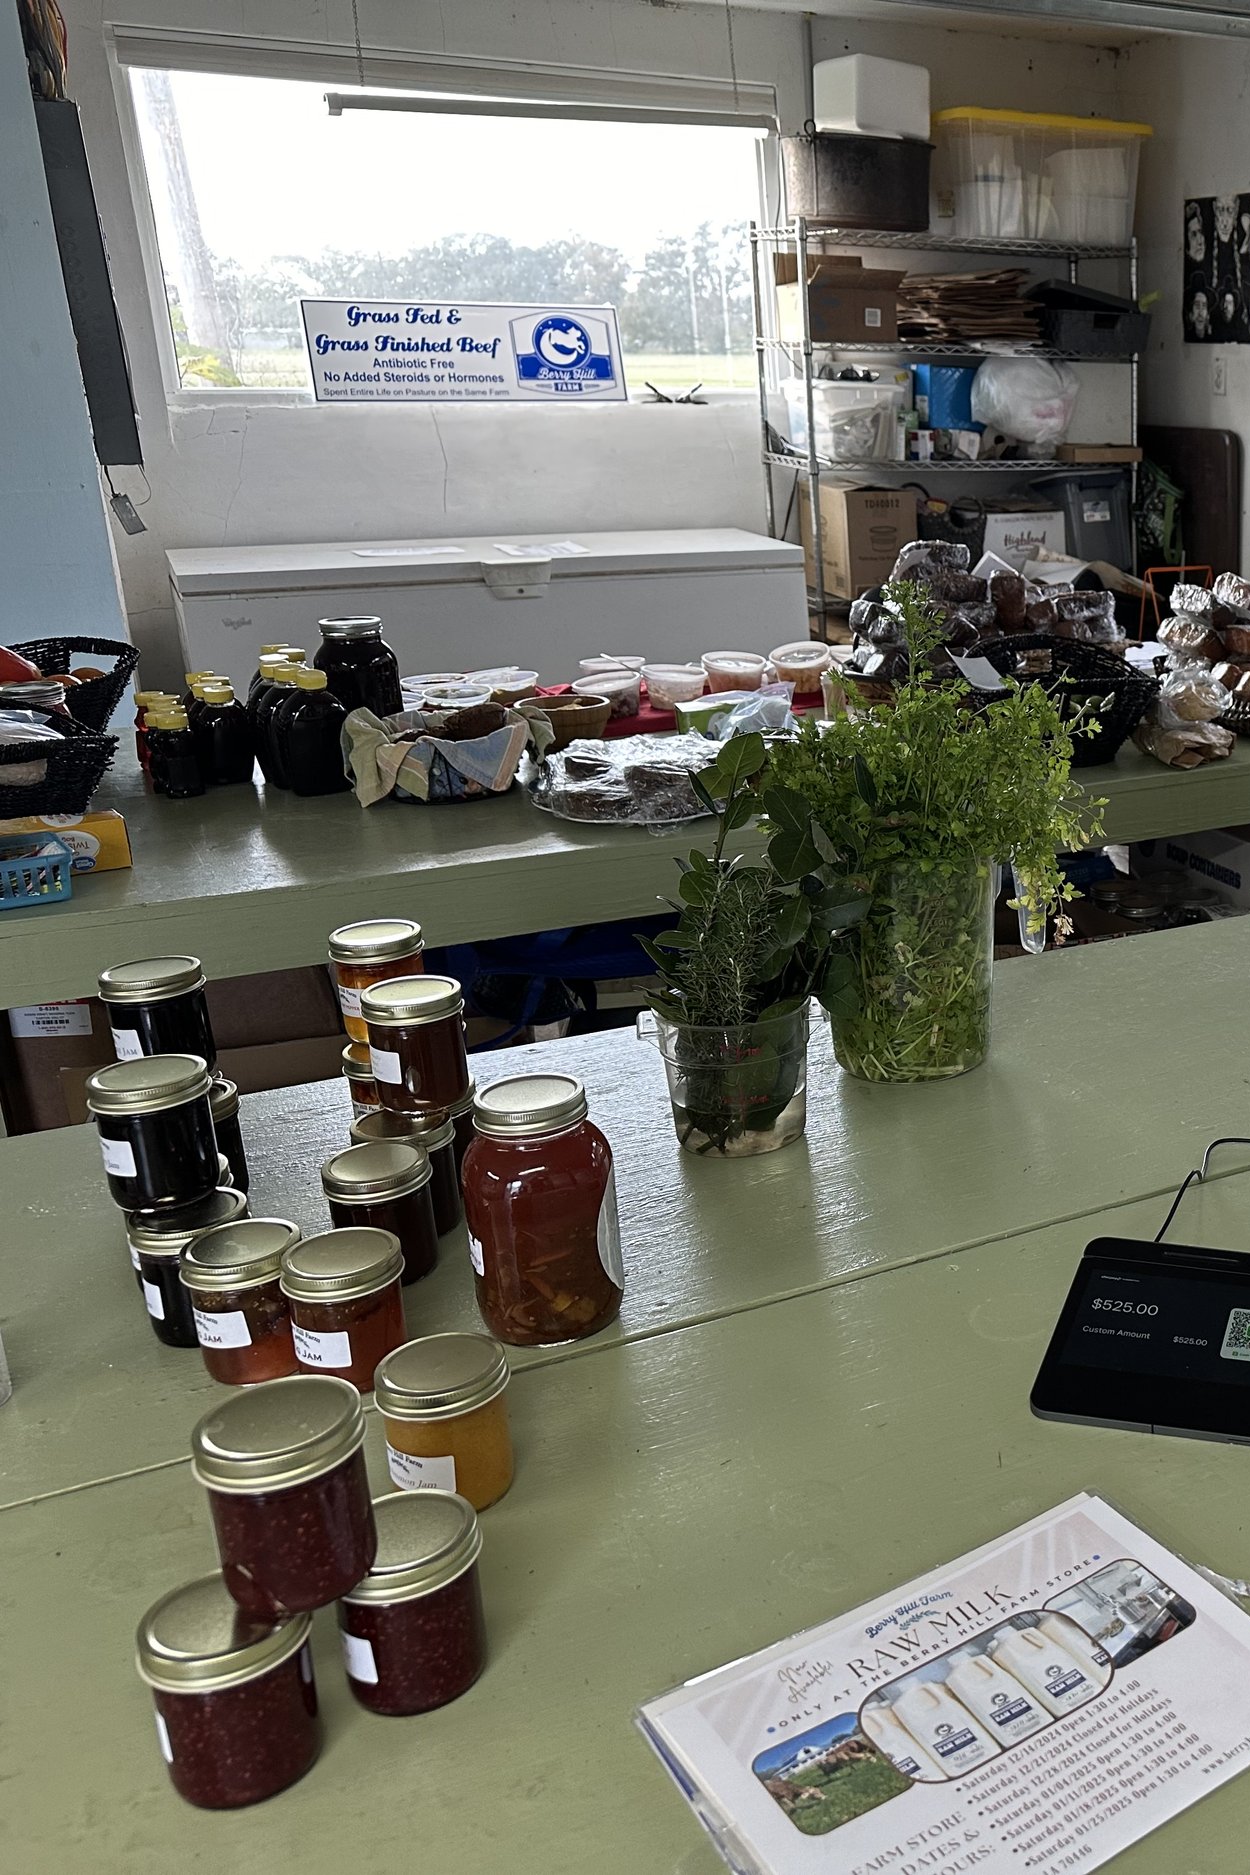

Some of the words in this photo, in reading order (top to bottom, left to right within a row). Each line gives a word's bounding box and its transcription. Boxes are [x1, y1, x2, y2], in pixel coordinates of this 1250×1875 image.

[347, 305, 400, 327] Grass
[405, 306, 442, 324] Fed
[447, 308, 462, 324] &
[315, 333, 369, 356] Grass
[374, 335, 451, 353] Finished
[456, 337, 501, 358] Beef
[373, 357, 428, 369] Antibiotic
[430, 358, 454, 369] Free
[538, 368, 571, 382] Berry
[573, 368, 596, 380] Hill
[324, 371, 340, 383] No
[344, 371, 381, 383] Added
[384, 371, 431, 383] Steroids
[433, 374, 445, 383] or
[449, 372, 504, 384] Hormones
[556, 383, 581, 391] FARM
[323, 387, 348, 398] Spent
[351, 387, 373, 397] Entire
[375, 387, 391, 397] Life
[393, 389, 403, 397] on
[405, 388, 436, 397] Pasture
[449, 388, 463, 397] the
[464, 388, 485, 397] Same
[487, 388, 510, 397] Farm
[1189, 852, 1242, 890] CONTAINERS
[122, 1046, 138, 1056] JAM
[1091, 1297, 1159, 1317] $525.00
[204, 1334, 223, 1344] JAM
[1082, 1325, 1115, 1336] Custom
[1117, 1327, 1151, 1340] Amount
[1173, 1335, 1208, 1347] $525.00
[301, 1351, 322, 1362] JAM
[405, 1455, 423, 1469] Farm
[865, 1614, 897, 1639] Berry
[895, 1600, 919, 1617] Hill
[919, 1590, 953, 1608] Farm
[778, 1703, 822, 1728] ONLY
[833, 1688, 851, 1703] AT
[859, 1668, 892, 1687] THE
[899, 1637, 949, 1667] BERRY
[957, 1615, 994, 1636] HILL
[1000, 1588, 1040, 1614] FARM
[1046, 1560, 1092, 1587] STORE
[846, 1628, 921, 1678] RAW
[928, 1585, 1012, 1635] MILK
[961, 1762, 1008, 1790] Saturday
[1007, 1728, 1062, 1764] 12/14/2024
[1060, 1715, 1087, 1732] Open
[1085, 1700, 1108, 1718] 1:30
[1106, 1694, 1120, 1705] to
[1118, 1679, 1141, 1696] 4:00
[972, 1774, 1018, 1803] Saturday
[1018, 1739, 1073, 1776] 12/21/2024
[1071, 1720, 1104, 1744] Closed
[1101, 1712, 1119, 1725] for
[1117, 1688, 1159, 1715] Holidays
[984, 1786, 1031, 1814] Saturday
[1030, 1749, 1087, 1787] 12/28/2024
[1085, 1730, 1118, 1753] Closed
[1115, 1721, 1133, 1735] for
[1131, 1698, 1172, 1724] Holidays
[994, 1798, 1041, 1827] Saturday
[1040, 1761, 1097, 1799] 01/04/2025
[1096, 1747, 1122, 1765] Open
[1120, 1732, 1144, 1750] 1:30
[1142, 1726, 1156, 1736] to
[1154, 1711, 1177, 1728] 4:00
[1006, 1809, 1053, 1839] Saturday
[1052, 1773, 1107, 1811] 01/11/2025
[1105, 1759, 1132, 1777] Open
[1130, 1744, 1154, 1762] 1:30
[1152, 1738, 1166, 1748] to
[1164, 1722, 1187, 1740] 4:00
[1017, 1821, 1065, 1852] Saturday
[1063, 1784, 1119, 1823] 01/18/2025
[1118, 1770, 1145, 1788] Open
[1143, 1754, 1167, 1773] 1:30
[1165, 1748, 1179, 1759] to
[1177, 1732, 1200, 1751] 4:00
[1028, 1835, 1076, 1865] Saturday
[1074, 1796, 1132, 1836] 01/25/2025
[1131, 1781, 1158, 1799] Open
[1156, 1765, 1180, 1784] 1:30
[1178, 1759, 1192, 1770] to
[1190, 1743, 1213, 1761] 4:00
[849, 1844, 904, 1875] FARM
[907, 1810, 967, 1850] STORE
[901, 1838, 961, 1875] DATES
[964, 1828, 981, 1842] &
[934, 1844, 997, 1875] OURS:
[1061, 1844, 1093, 1870] 70446
